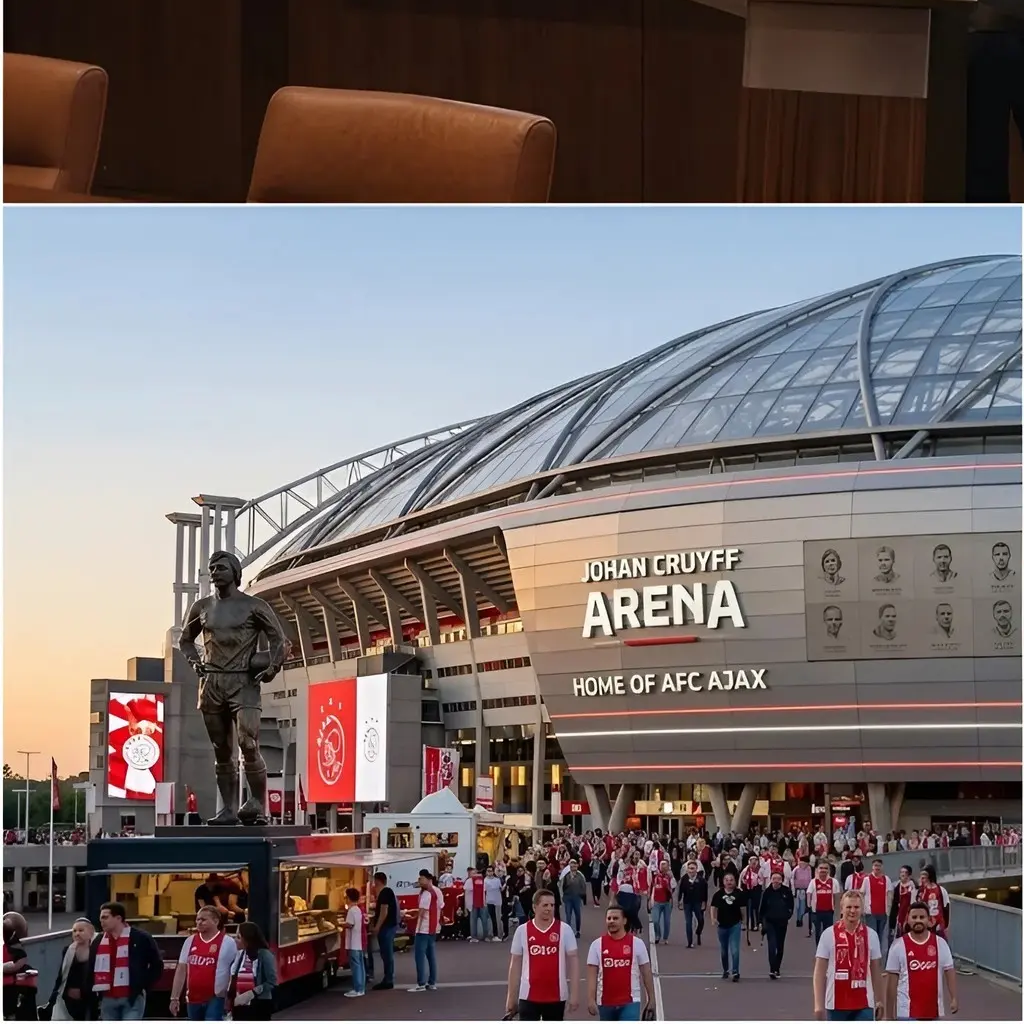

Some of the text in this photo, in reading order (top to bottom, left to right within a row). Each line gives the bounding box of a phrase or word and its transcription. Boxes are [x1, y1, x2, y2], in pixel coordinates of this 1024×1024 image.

[580, 548, 742, 584] JOHAN CRUYFF
[581, 579, 747, 639] ARENA
[572, 668, 768, 697] HOME OF AFC AJAX
